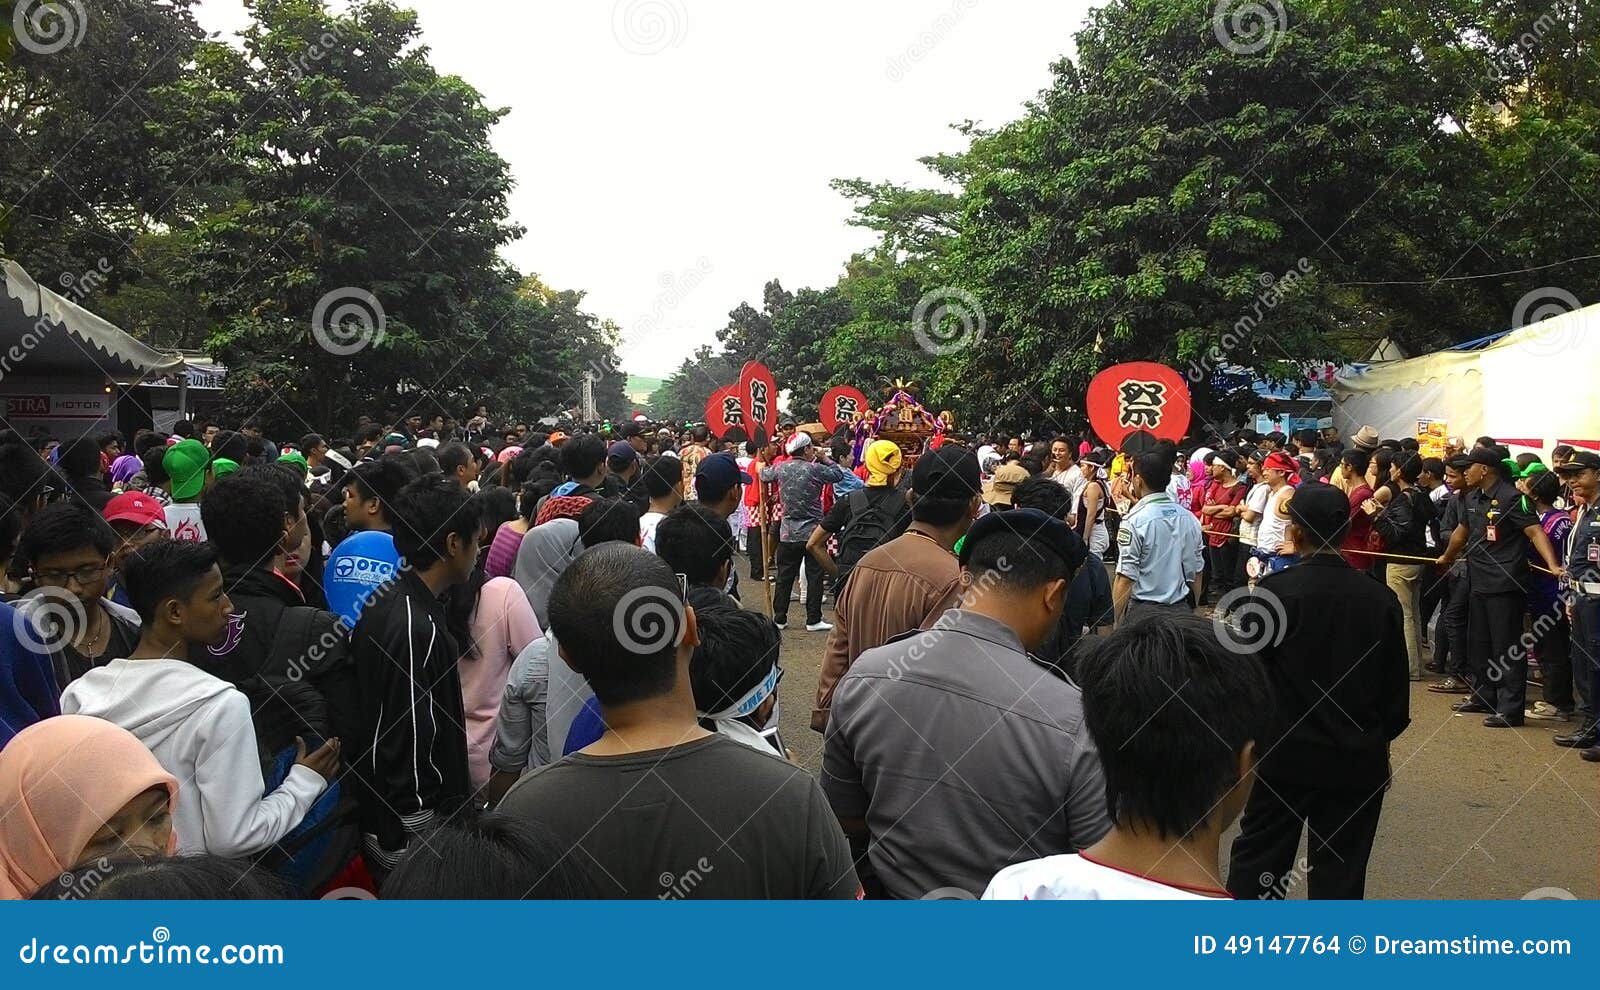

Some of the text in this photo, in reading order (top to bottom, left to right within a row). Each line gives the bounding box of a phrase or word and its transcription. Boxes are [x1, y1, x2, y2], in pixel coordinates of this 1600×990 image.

[55, 401, 101, 409] MOTOR
[751, 379, 768, 423] 祭
[1119, 380, 1166, 428] 祭
